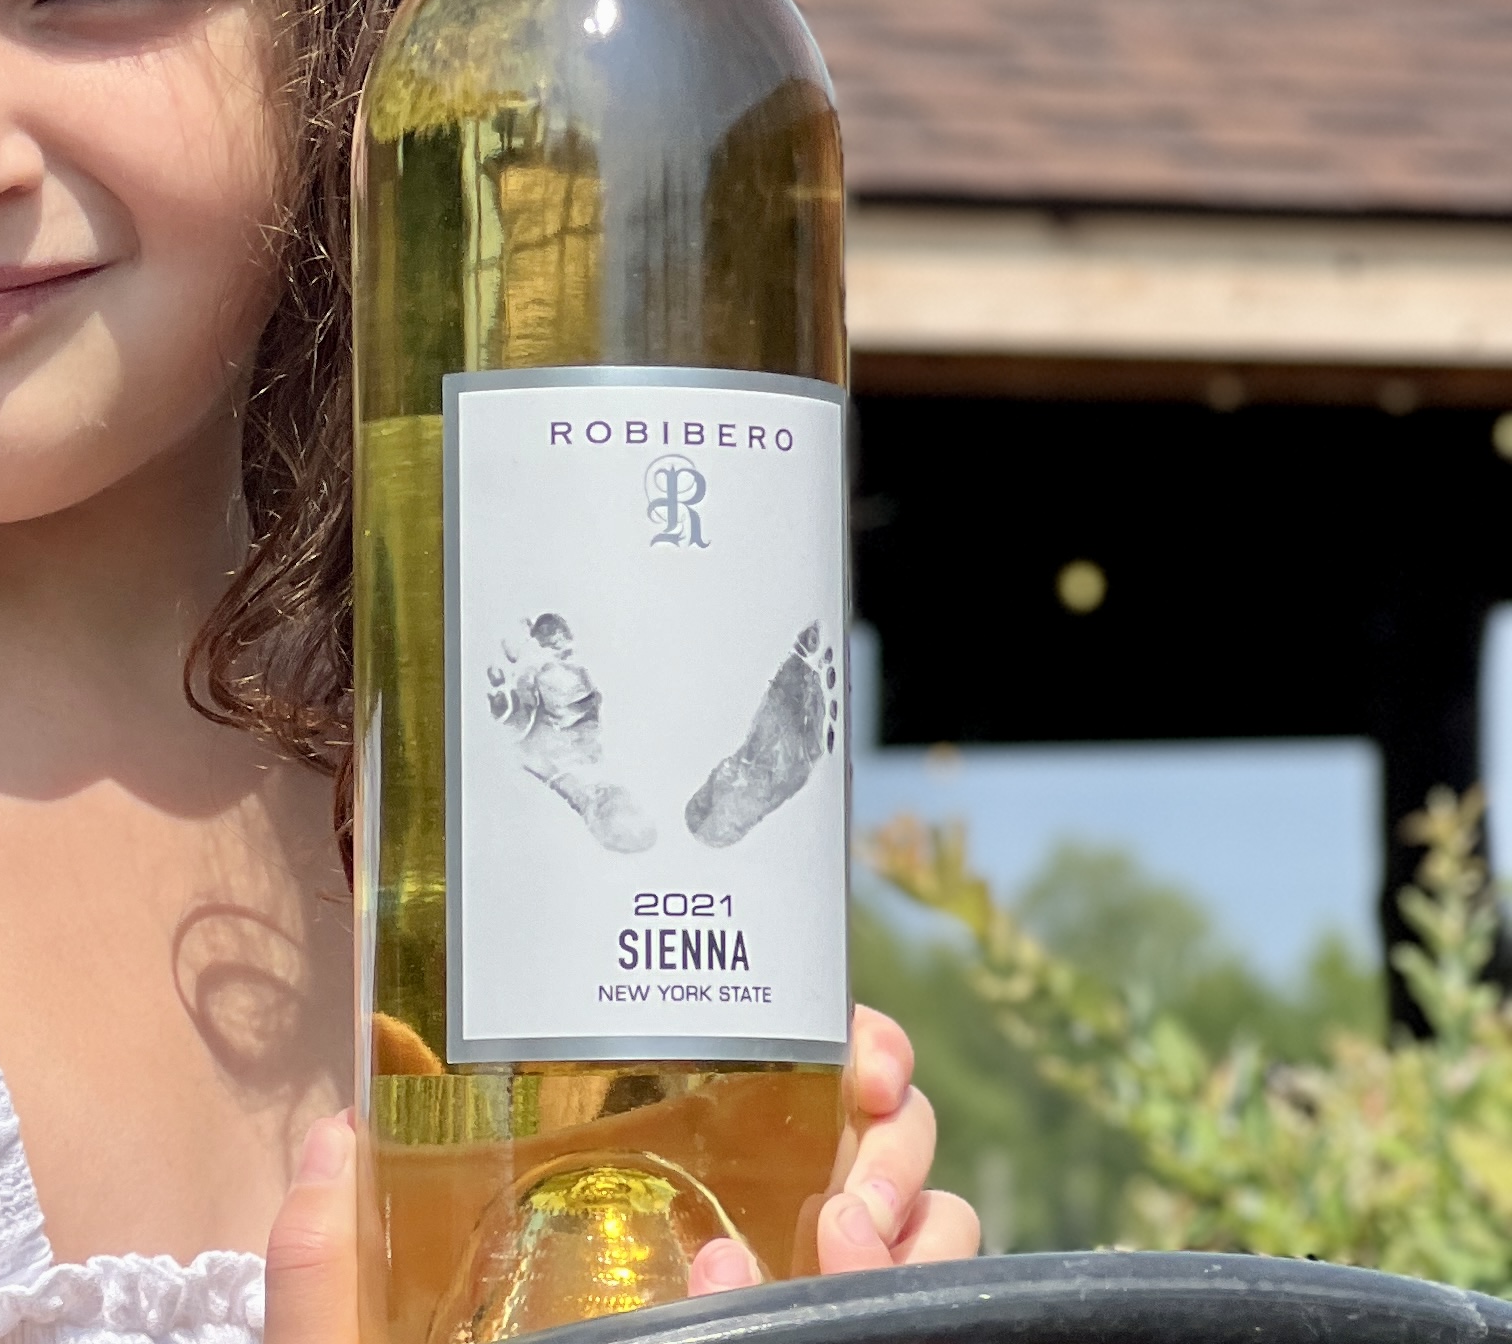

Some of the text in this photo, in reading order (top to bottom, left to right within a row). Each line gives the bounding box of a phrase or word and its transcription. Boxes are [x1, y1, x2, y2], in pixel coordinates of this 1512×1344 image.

[551, 421, 794, 452] ROBIBERO
[644, 454, 711, 549] R
[633, 893, 732, 918] 2021
[618, 928, 750, 972] SIENNA
[598, 984, 772, 1004] NEW YORK STATE
